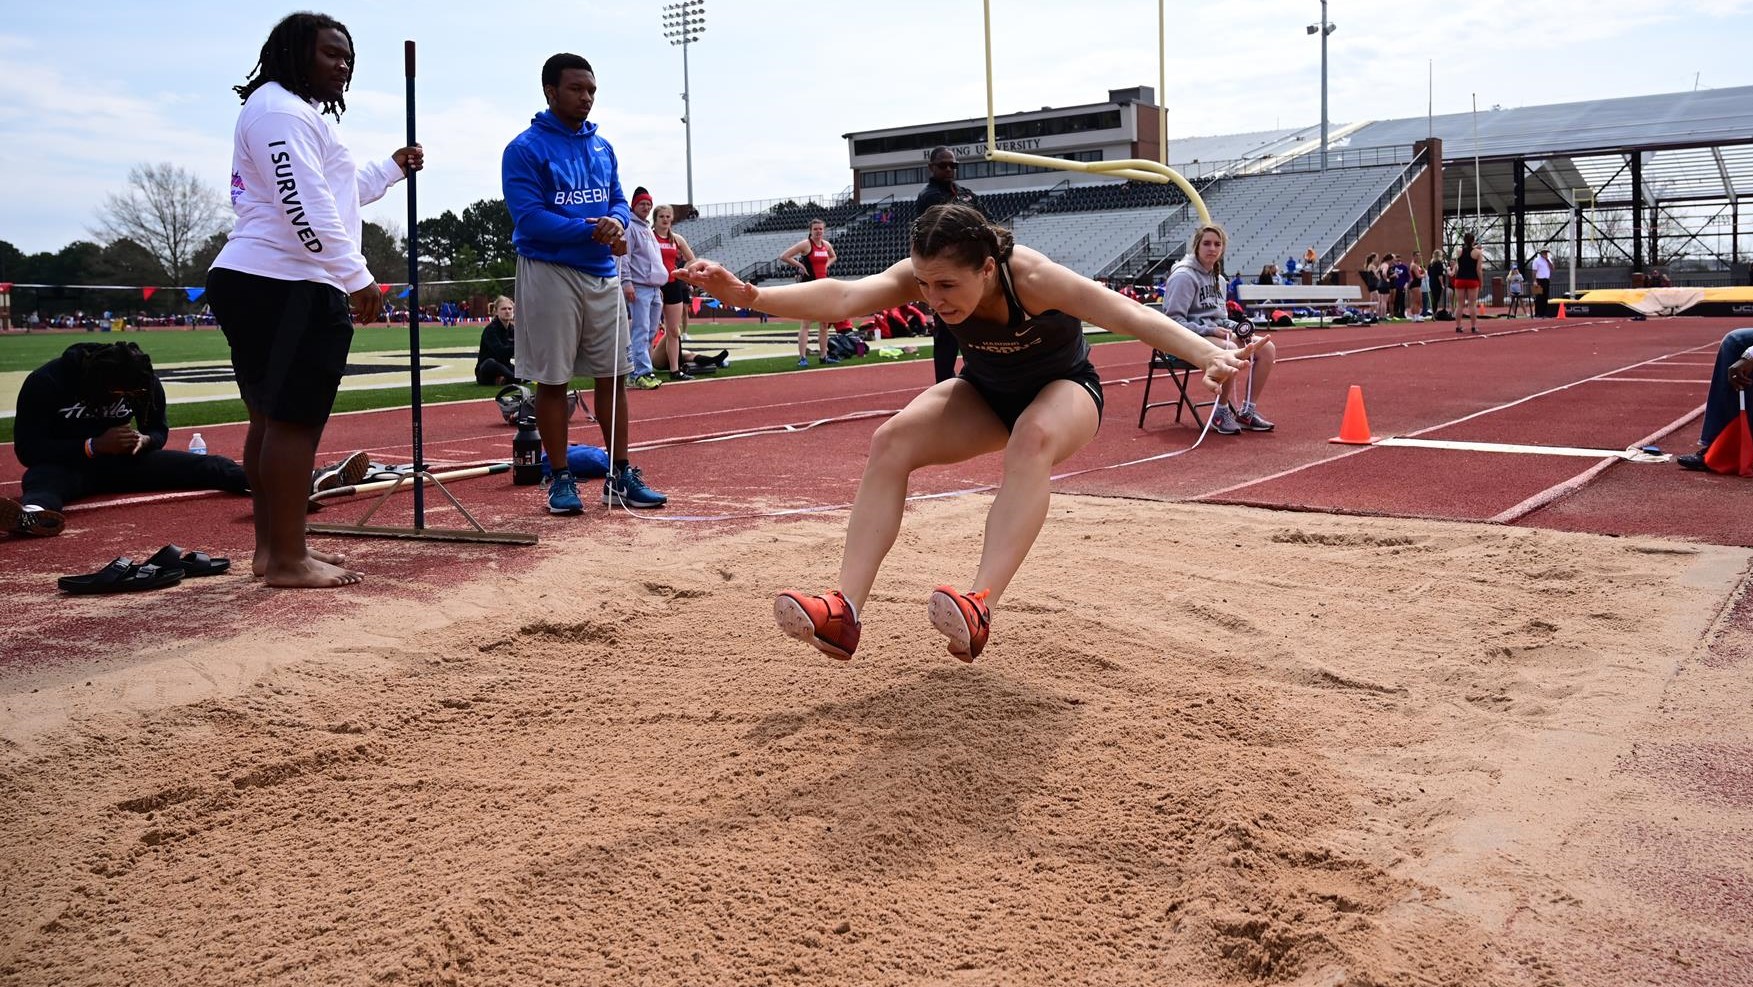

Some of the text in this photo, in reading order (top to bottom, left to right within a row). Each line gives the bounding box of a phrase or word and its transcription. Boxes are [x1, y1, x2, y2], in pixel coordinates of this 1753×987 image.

[923, 138, 1041, 160] HING UNVERSITY
[549, 156, 612, 191] NIKE
[268, 140, 323, 254] I SURVIVED
[554, 187, 610, 205] BASEBA
[1731, 305, 1753, 313] UC
